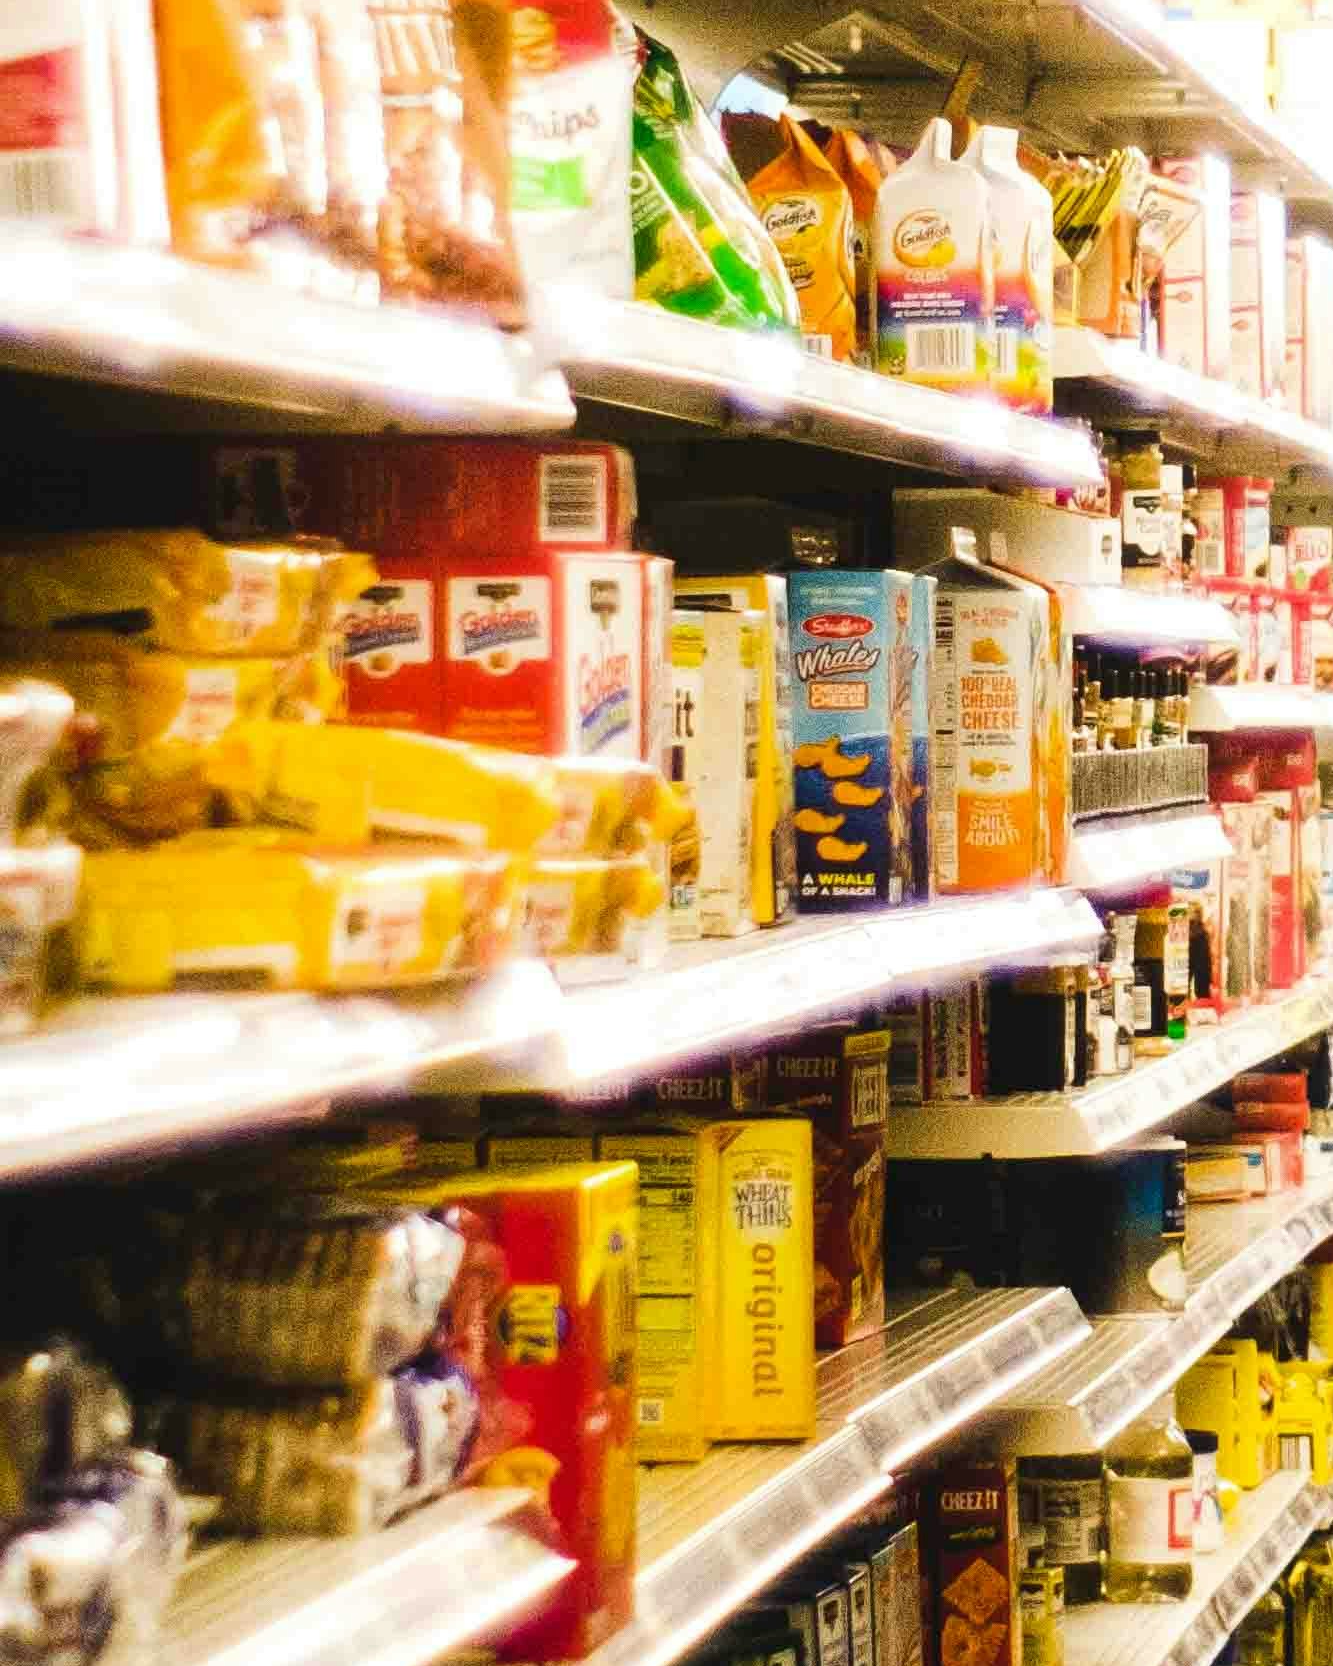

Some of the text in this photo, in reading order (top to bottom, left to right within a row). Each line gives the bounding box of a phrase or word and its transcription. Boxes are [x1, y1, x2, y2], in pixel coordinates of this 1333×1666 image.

[765, 205, 817, 232] Goldfish
[900, 222, 951, 249] Goldfish
[796, 638, 881, 681] Whales
[818, 873, 876, 885] WHALE
[733, 1185, 793, 1204] WHEAT
[735, 1204, 793, 1231] THINS
[745, 1243, 784, 1397] original
